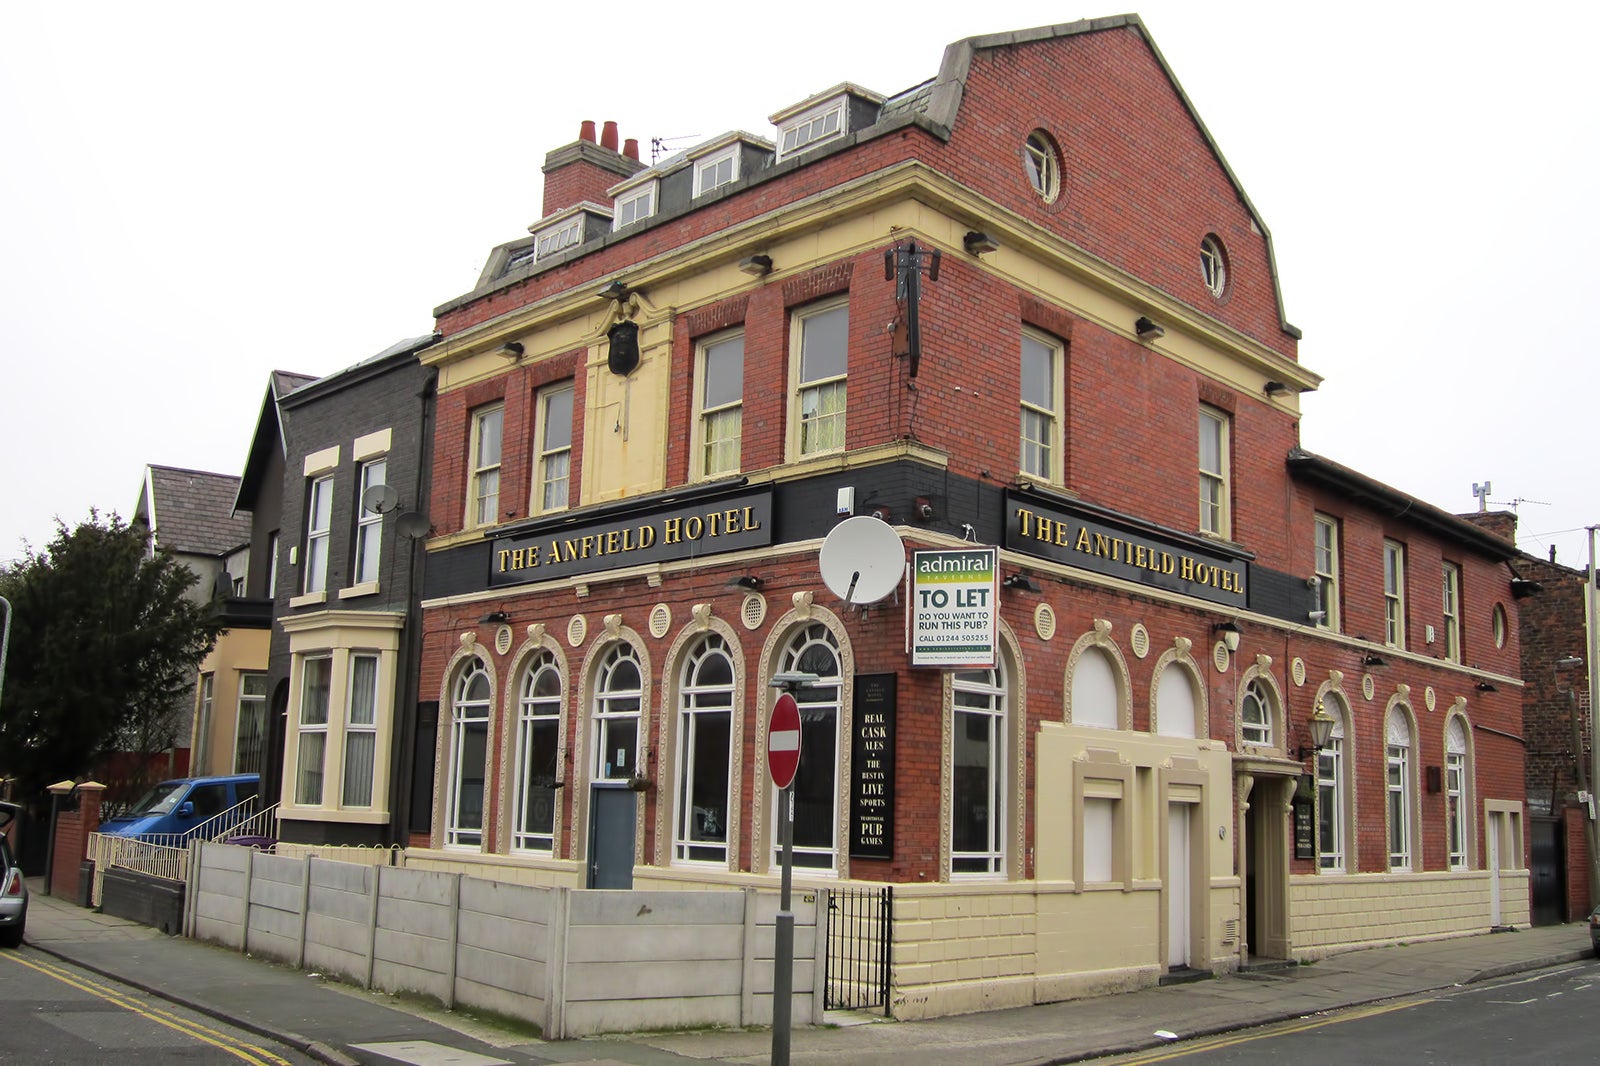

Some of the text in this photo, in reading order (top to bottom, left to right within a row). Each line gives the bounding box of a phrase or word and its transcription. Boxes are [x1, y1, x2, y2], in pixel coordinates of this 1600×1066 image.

[498, 506, 760, 573] THE ANFIELD HOTEL
[1017, 508, 1244, 594] THE ANFIELD HOTEL
[920, 554, 989, 573] admiral
[919, 588, 990, 609] TO LET
[919, 613, 932, 621] DO
[952, 612, 976, 620] WANT
[919, 620, 988, 630] RUN THIS PUB?
[961, 634, 989, 642] 505255
[864, 714, 884, 723] REAL
[861, 727, 886, 738] CASK
[864, 742, 884, 751] ALES
[867, 760, 880, 768] THE
[862, 772, 877, 780] BEST
[862, 784, 883, 795] LIVE
[860, 799, 886, 807] SPORTS
[861, 823, 882, 835] PUB
[860, 837, 882, 845] GAMES
